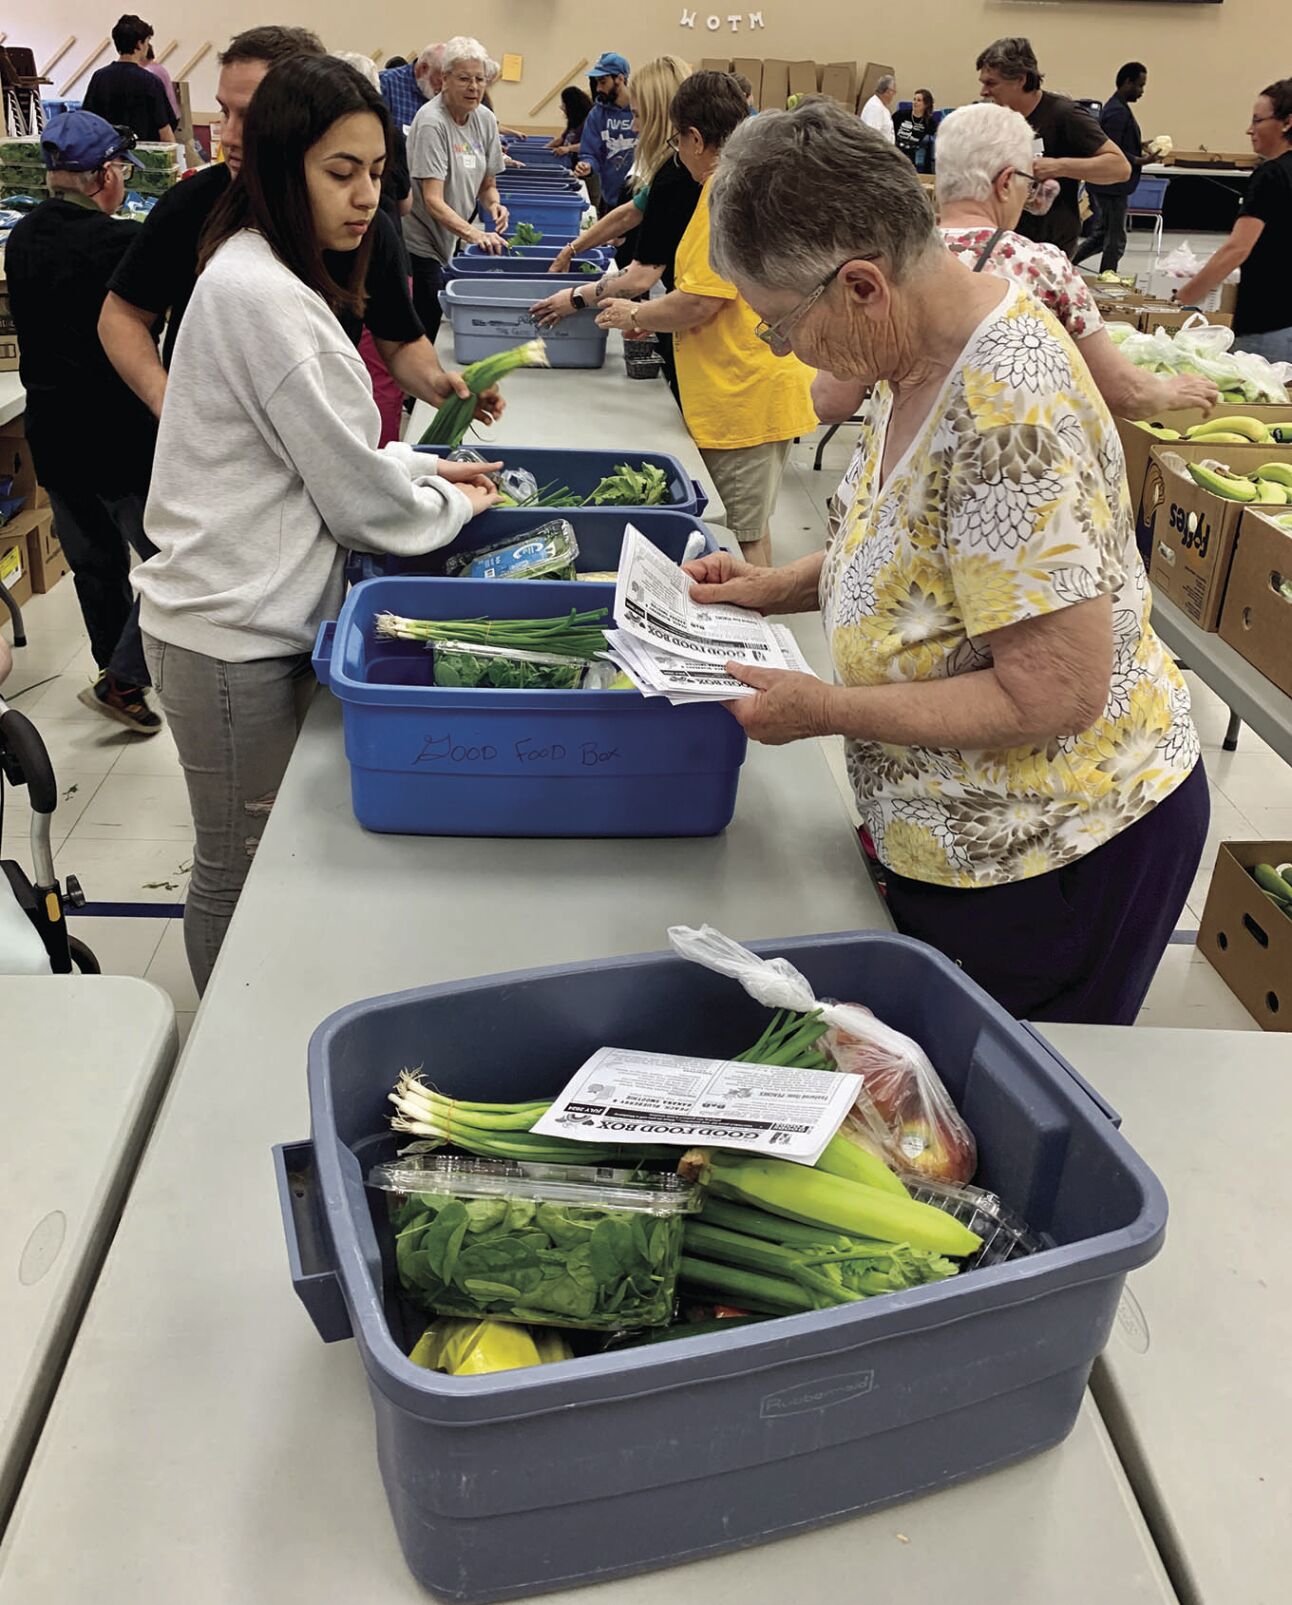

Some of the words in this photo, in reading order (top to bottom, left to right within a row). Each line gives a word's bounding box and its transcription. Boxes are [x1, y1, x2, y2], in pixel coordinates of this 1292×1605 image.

[646, 624, 671, 642] BOX
[672, 635, 706, 654] FOOD
[705, 647, 746, 658] GOOD
[595, 1120, 638, 1132] BOX
[642, 1123, 698, 1135] FOOD
[698, 1128, 760, 1140] GOOD
